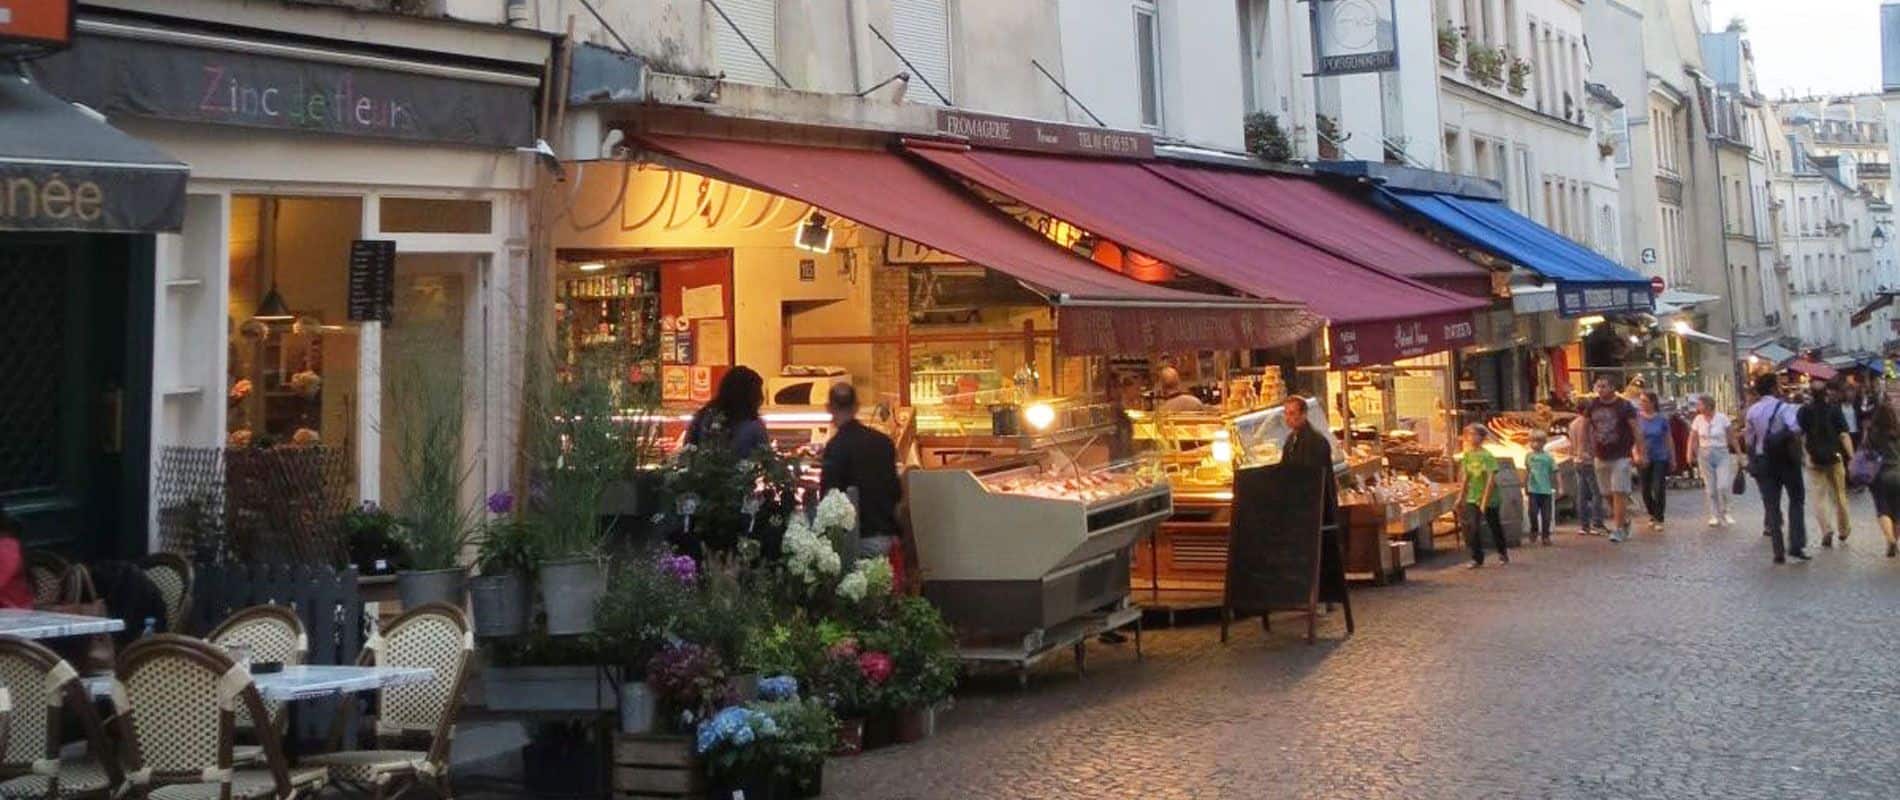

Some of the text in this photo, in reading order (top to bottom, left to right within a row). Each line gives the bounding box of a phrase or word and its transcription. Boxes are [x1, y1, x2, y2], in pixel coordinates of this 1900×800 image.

[201, 64, 278, 117] Zinc
[947, 115, 1011, 139] FROMAGERIE
[0, 171, 103, 221] née
